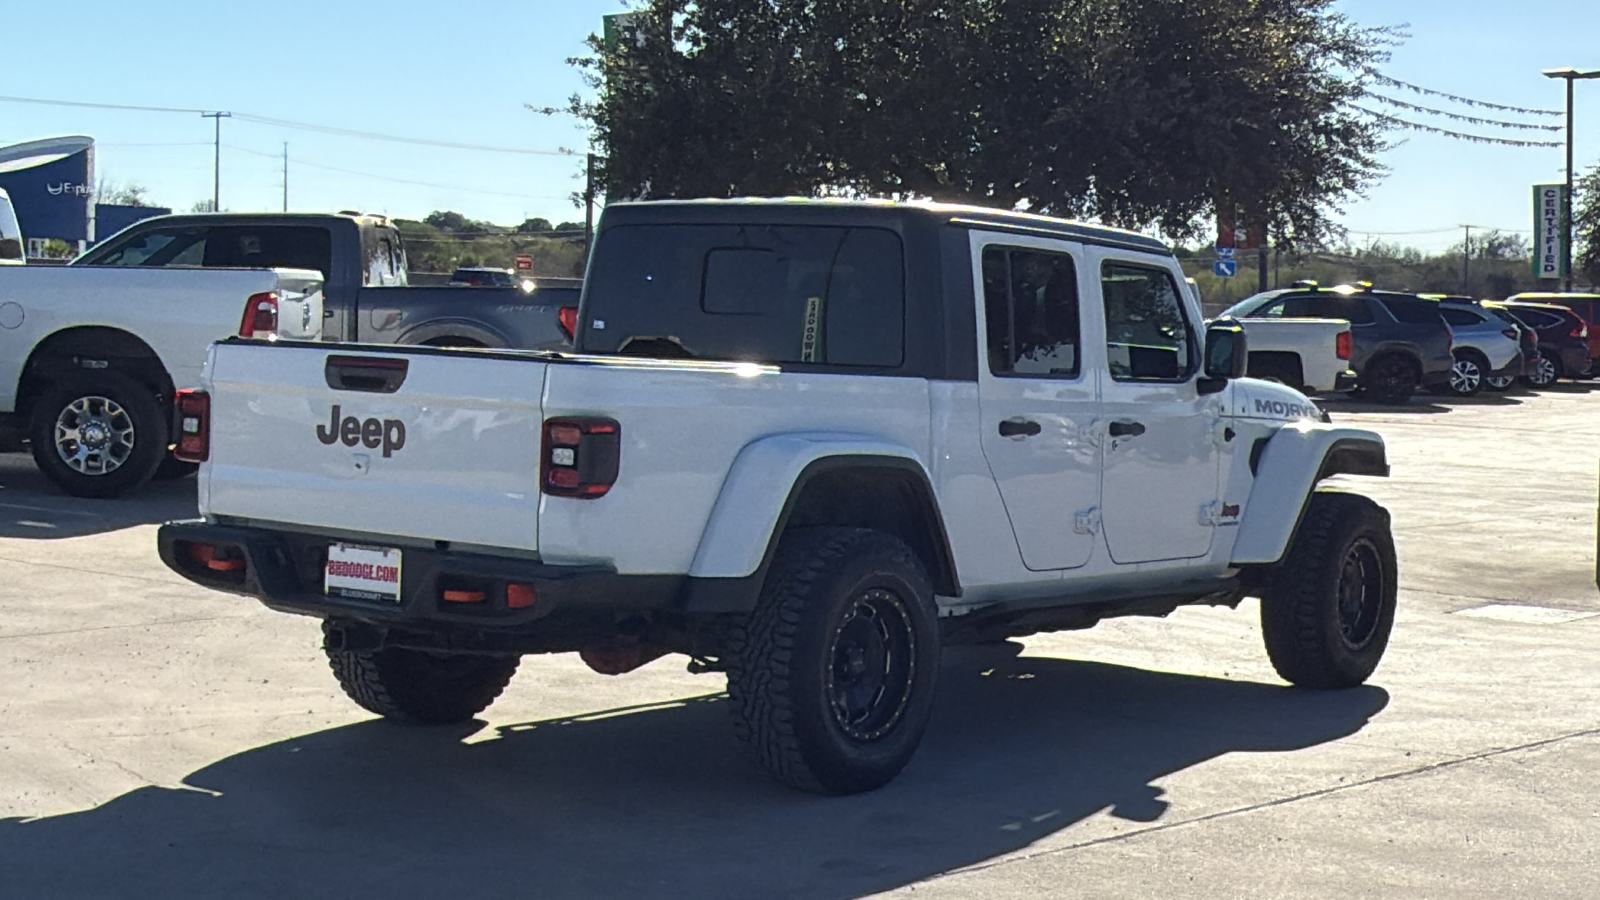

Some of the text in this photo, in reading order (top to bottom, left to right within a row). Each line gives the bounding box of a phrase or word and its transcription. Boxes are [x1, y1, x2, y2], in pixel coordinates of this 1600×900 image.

[1544, 189, 1556, 273] CERTIFIED
[316, 404, 406, 458] Jeep
[1254, 398, 1318, 418] MOJAVE
